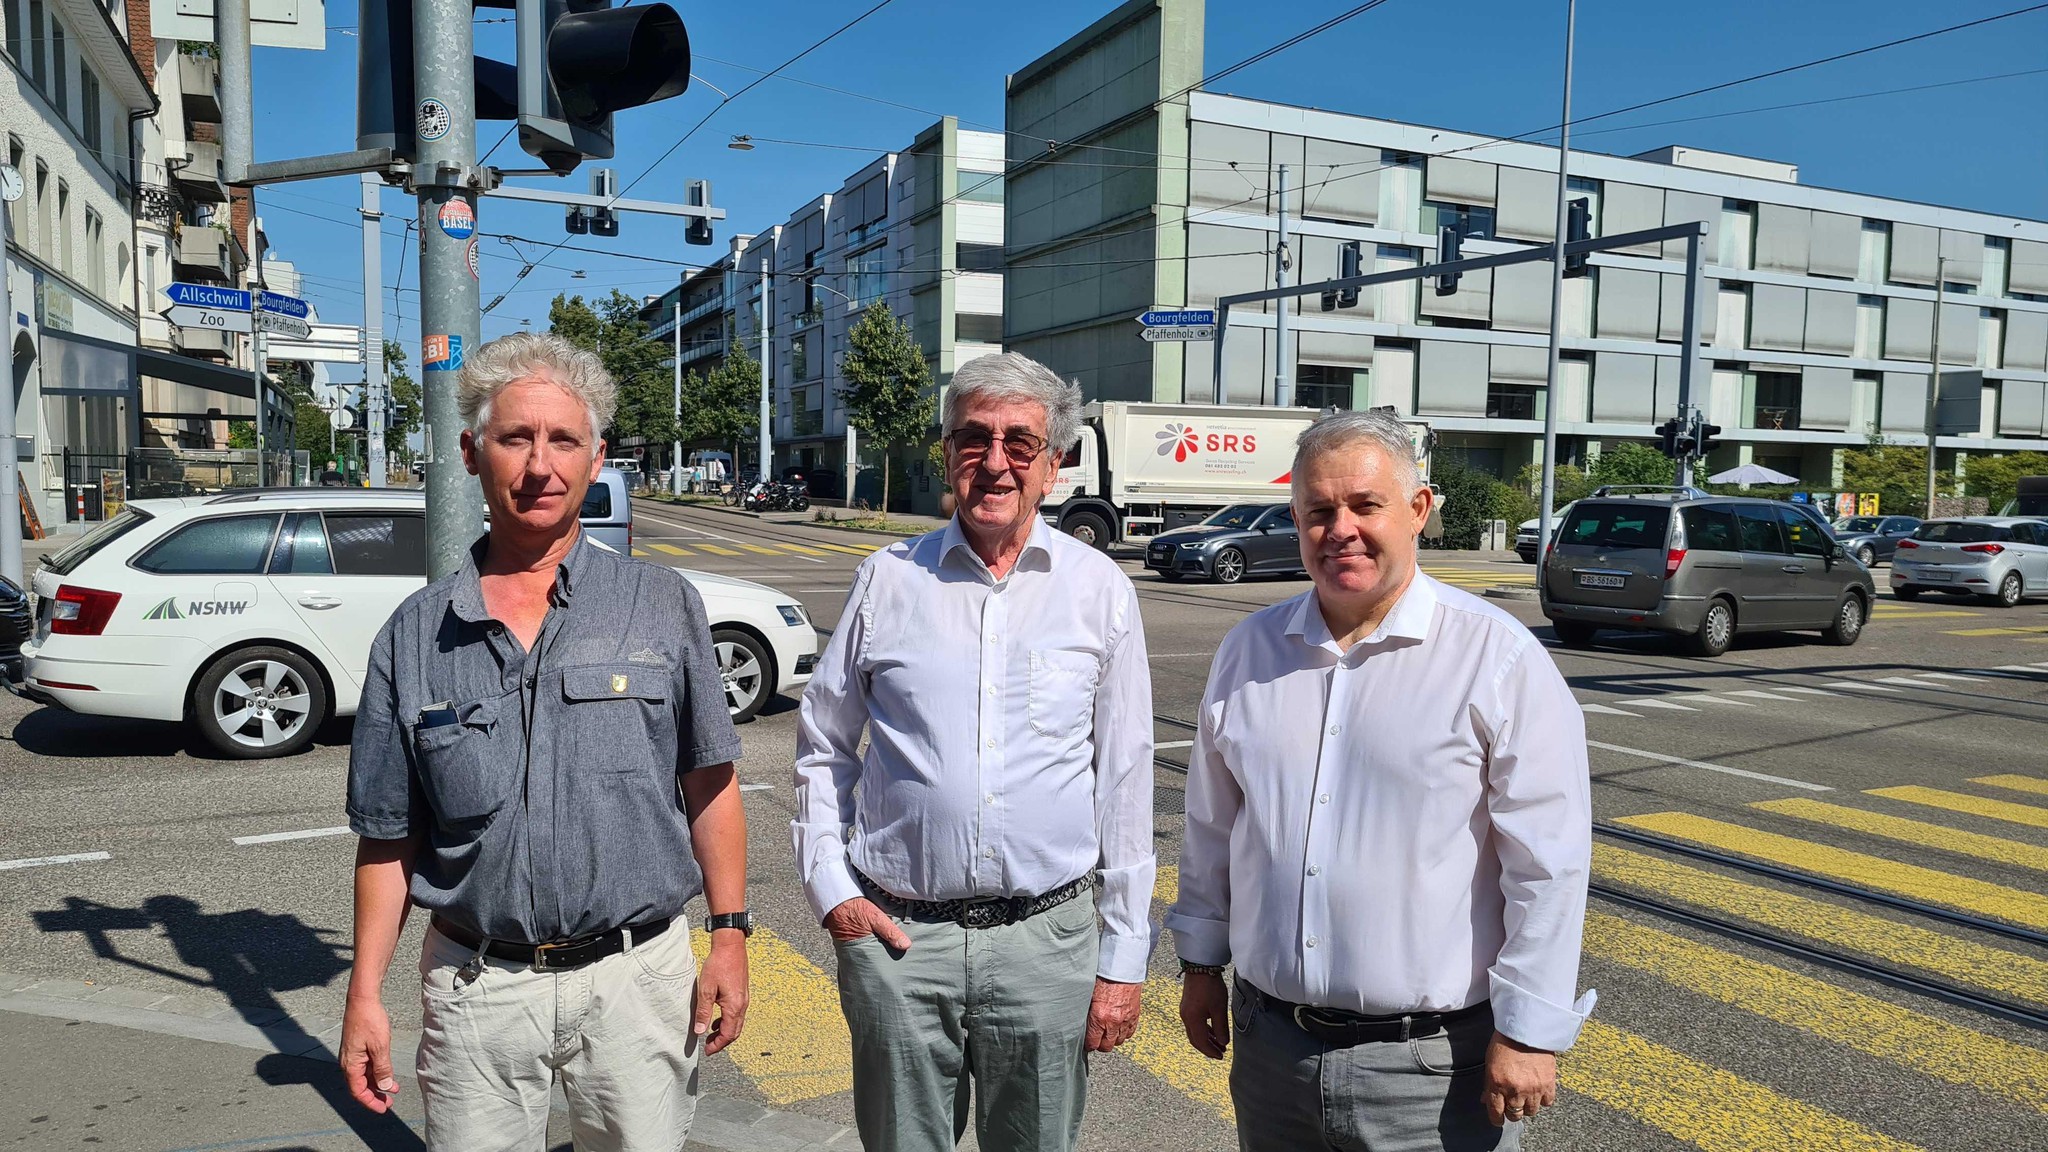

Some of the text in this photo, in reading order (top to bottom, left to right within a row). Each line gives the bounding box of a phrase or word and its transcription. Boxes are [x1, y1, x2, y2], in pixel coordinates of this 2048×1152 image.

[443, 215, 473, 230] BASEL
[180, 286, 243, 307] Allschwil
[262, 292, 304, 315] Bourgfelden
[200, 312, 225, 327] Zoo
[272, 316, 306, 336] Pfaffenholz
[1149, 312, 1209, 325] Bourgfelden
[1146, 328, 1194, 339] Pfaffenholz
[1206, 433, 1256, 453] SRS
[188, 601, 248, 616] NSNW
